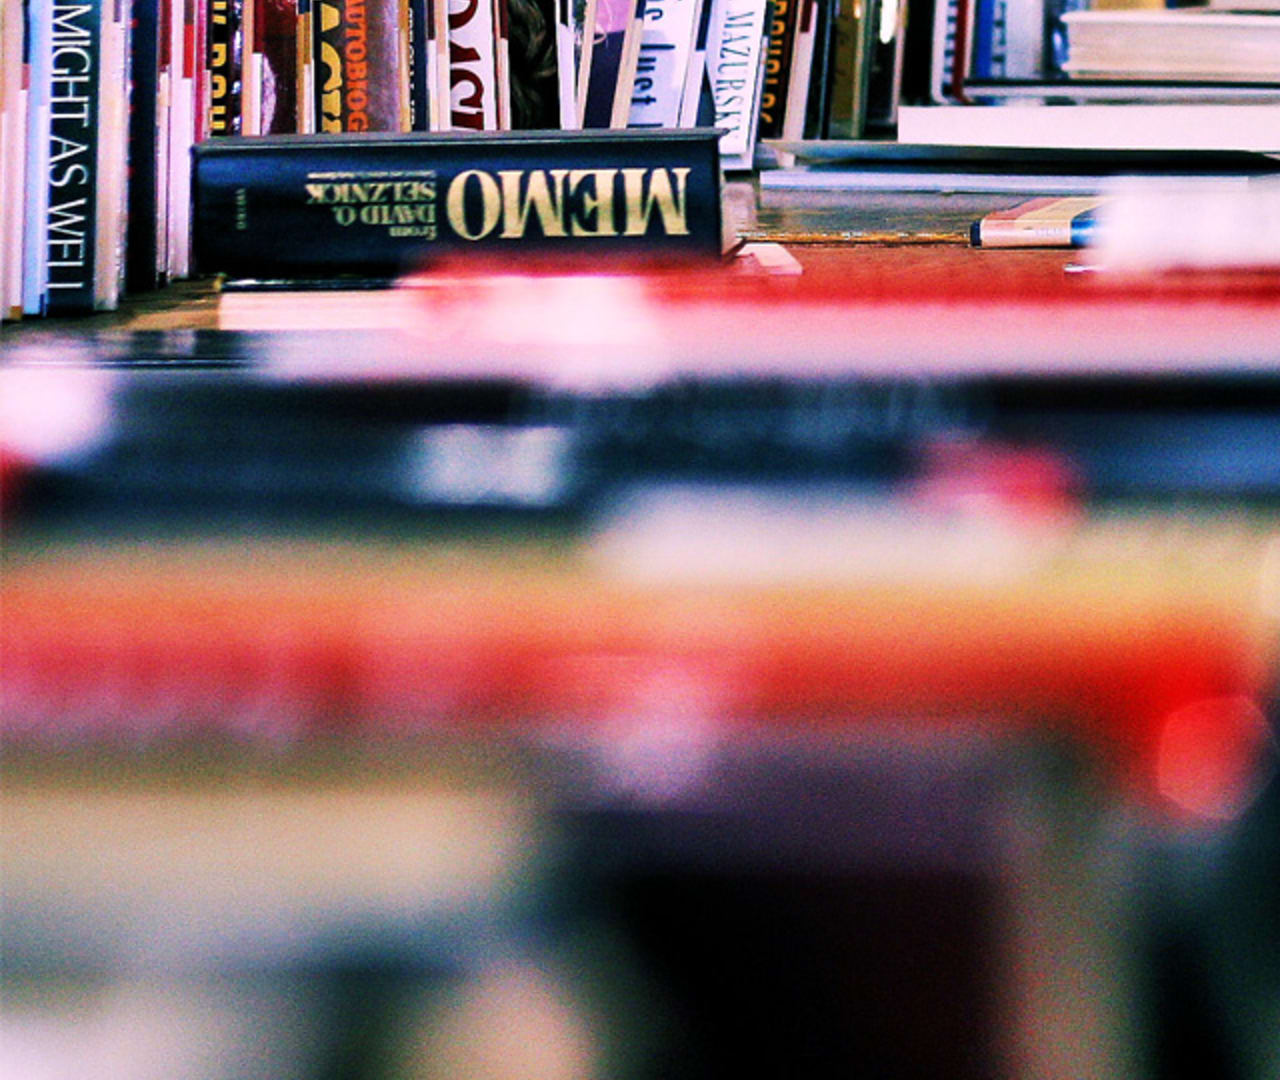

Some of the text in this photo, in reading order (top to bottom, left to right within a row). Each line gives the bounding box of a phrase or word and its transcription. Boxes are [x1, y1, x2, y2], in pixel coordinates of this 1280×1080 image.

[51, 4, 92, 128] MIGHT
[49, 133, 89, 187] AS
[304, 181, 437, 204] SELZNICK
[360, 204, 436, 225] DAVID
[447, 166, 692, 241] MEMO
